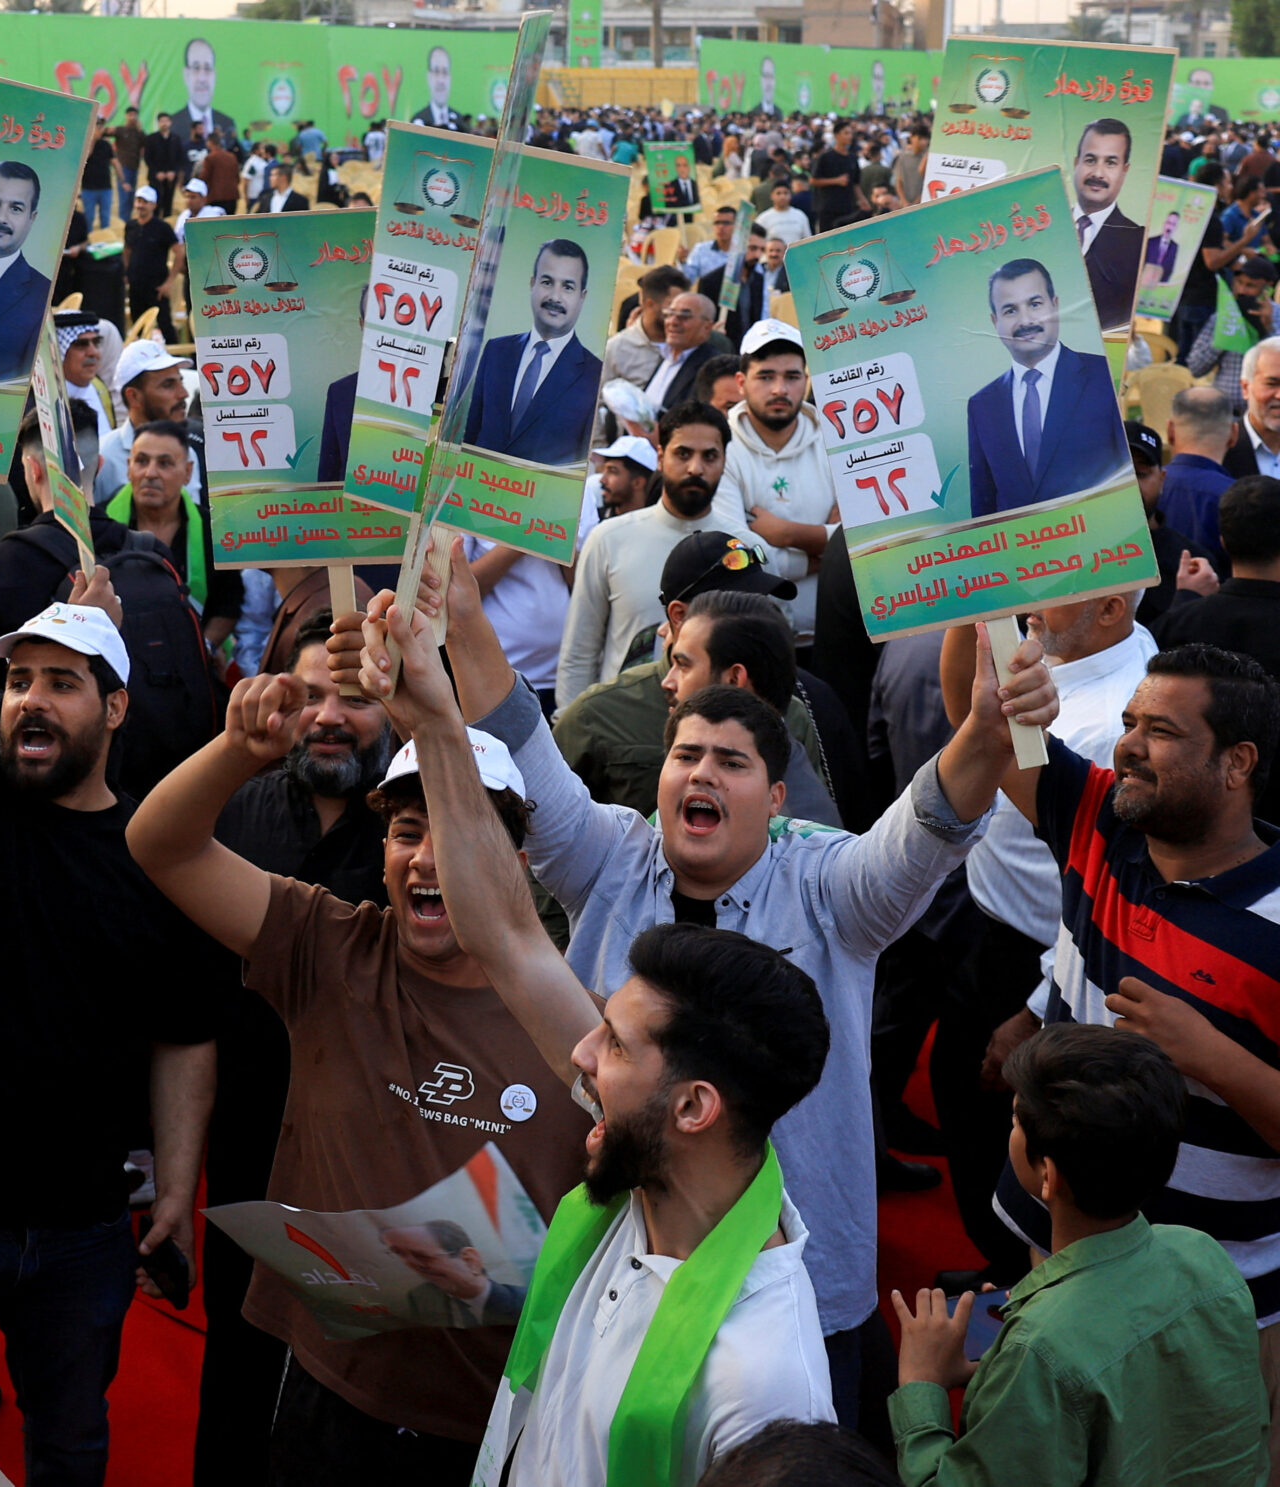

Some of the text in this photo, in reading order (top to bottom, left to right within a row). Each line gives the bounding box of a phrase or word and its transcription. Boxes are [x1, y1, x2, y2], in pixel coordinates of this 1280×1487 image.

[338, 64, 403, 119] ٢٥٧
[706, 69, 745, 110] ٢٥٧
[1044, 73, 1116, 102] وازدهار
[940, 156, 985, 175] رقم القائمة
[511, 183, 571, 221] وازدها
[387, 219, 451, 245] دولة القانون
[925, 220, 1008, 268] وازدهار
[309, 239, 373, 267] ازدهار
[388, 259, 434, 283] رقم القائمة
[201, 297, 306, 319] ائتلاف دولة القانون
[373, 282, 443, 332] ٢٥٧
[211, 337, 261, 351] رقم القائمة
[813, 304, 929, 351] ائتلاف دولة القانون
[201, 359, 276, 396] ٢٥٧
[378, 359, 421, 407] ٦٢
[829, 362, 885, 385] رقم القائمة
[822, 383, 905, 440] ٢٥٧
[222, 429, 268, 468] ٦٢
[352, 464, 417, 495] الياسري
[478, 469, 536, 499] العميد
[855, 467, 909, 516] ٦٢
[257, 497, 344, 520] المهندس
[469, 497, 522, 525] محمد
[220, 525, 402, 551] محمد حسن الياسري
[523, 517, 567, 541] حيدر
[907, 514, 1087, 574] العميد المهندس
[870, 541, 1143, 620] حيدر محمد حسن الياسري
[388, 1082, 512, 1134] #NO.1 EWS BAG "MINI"
